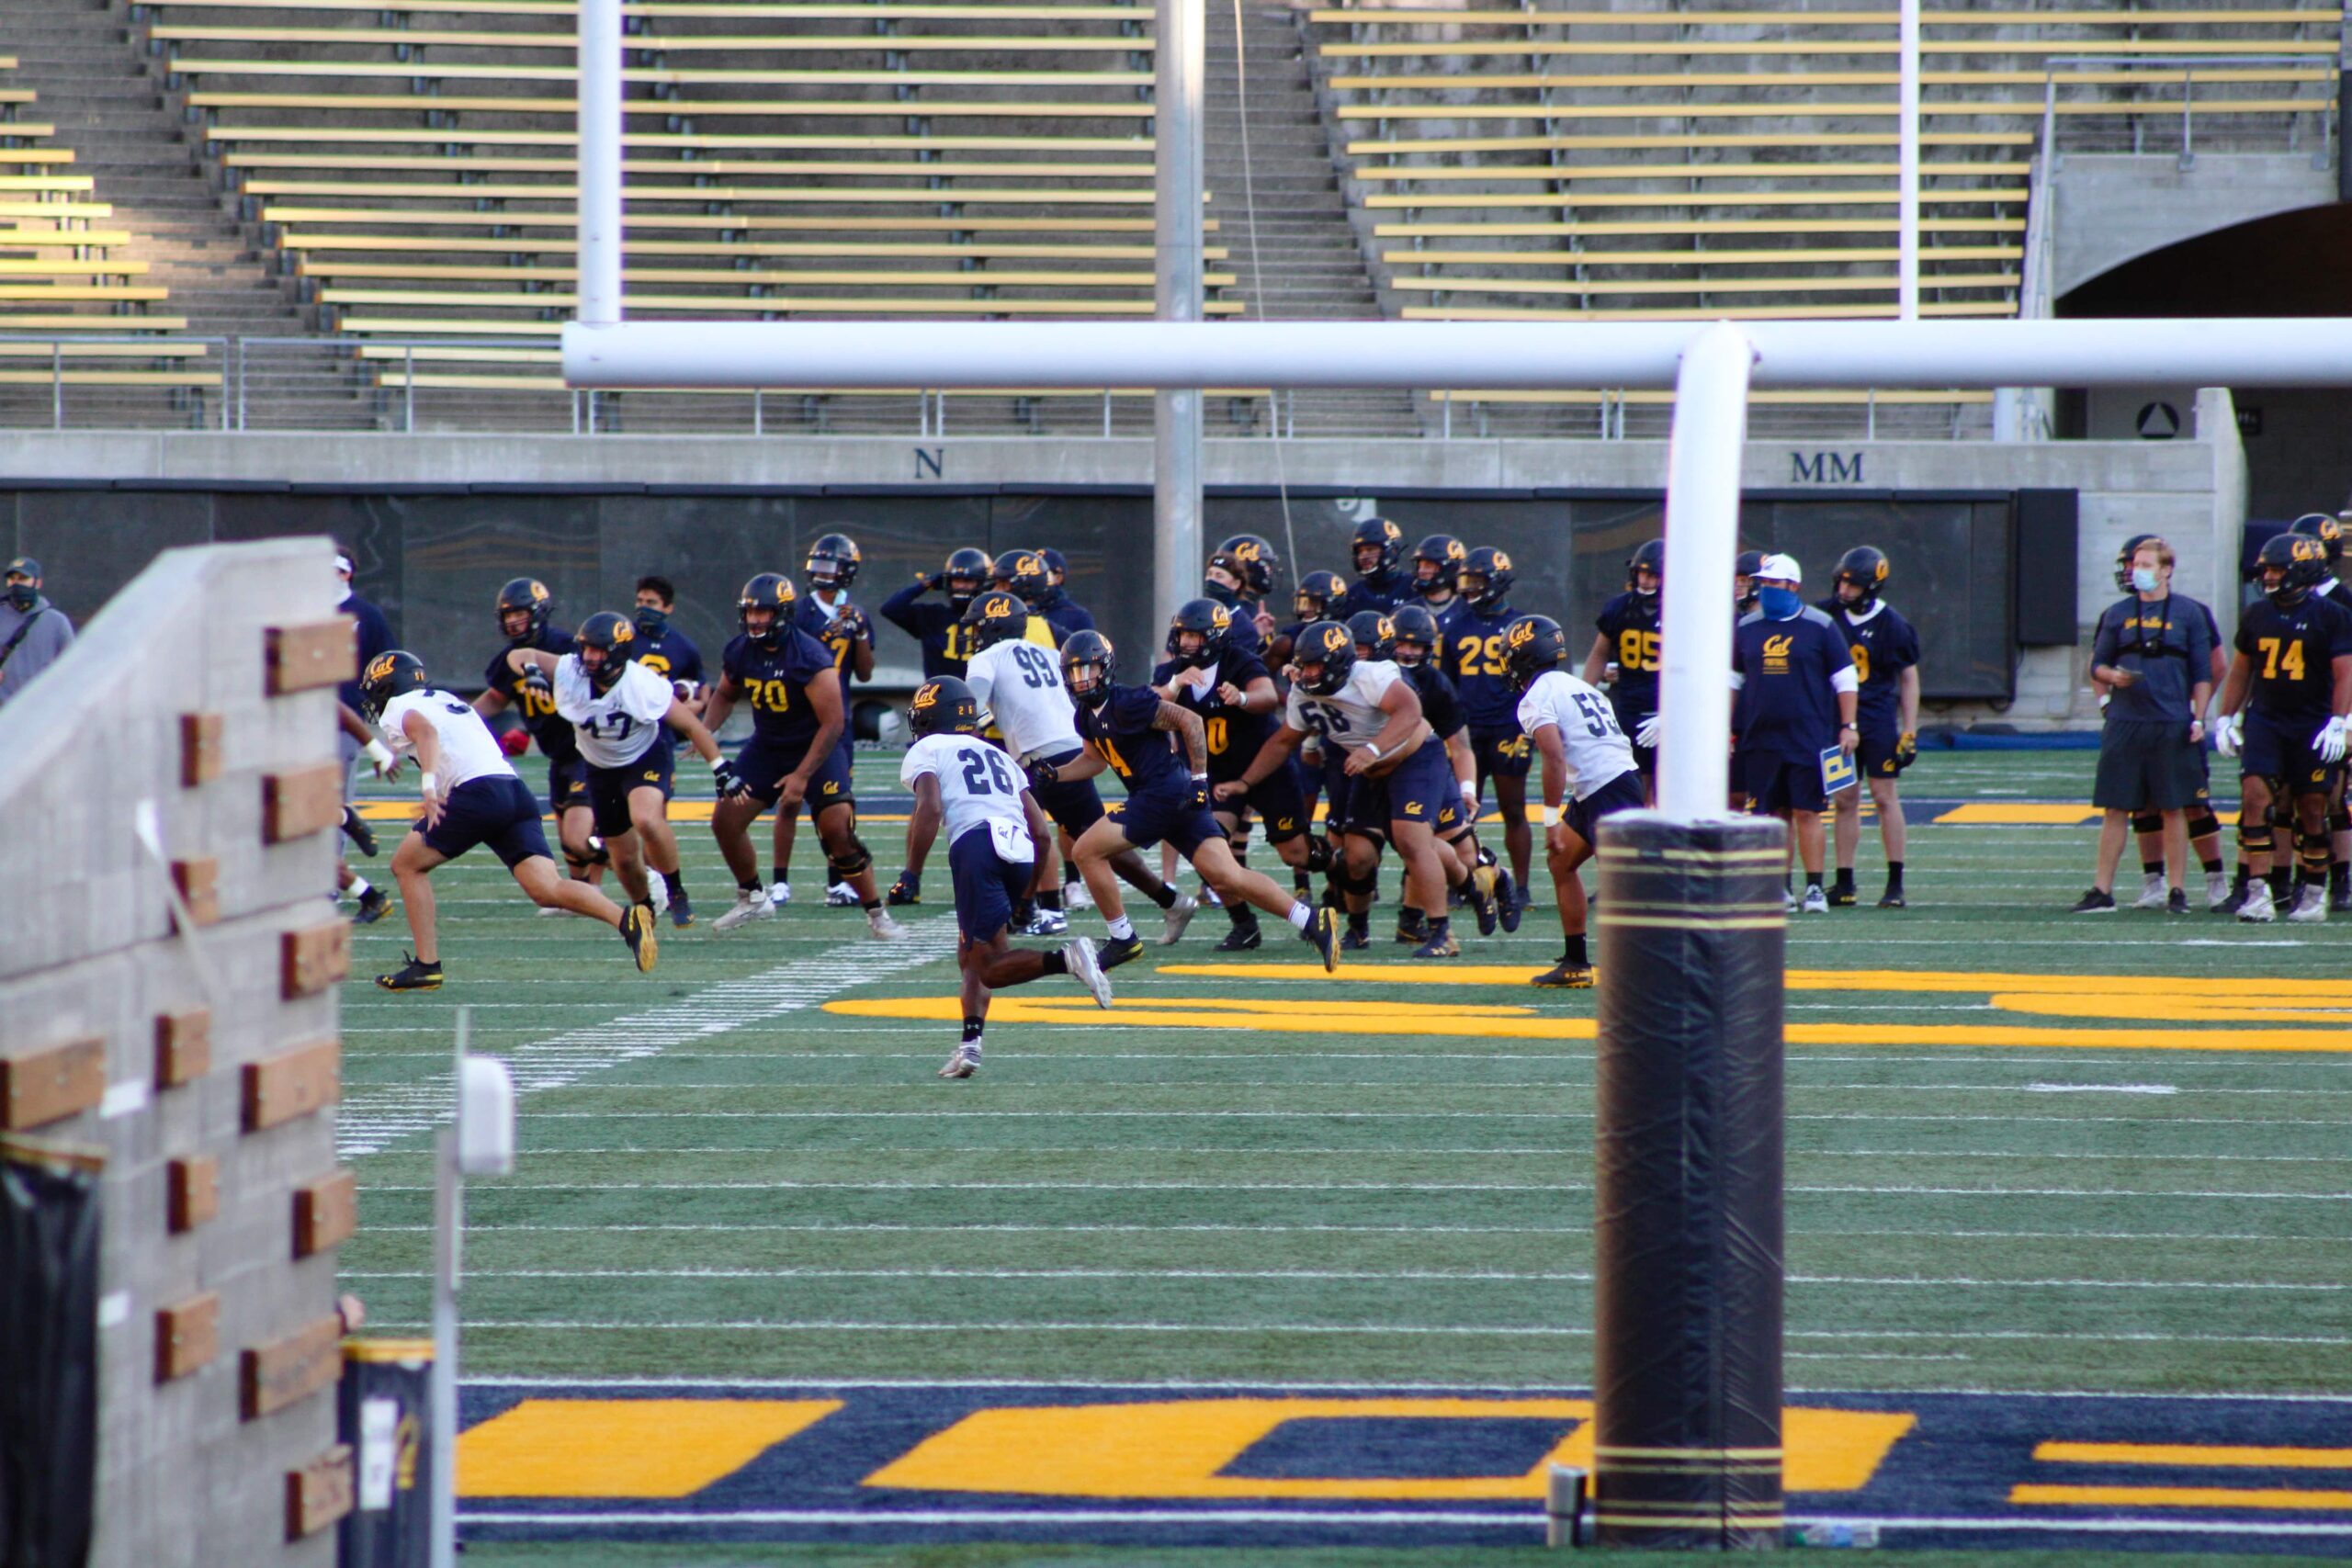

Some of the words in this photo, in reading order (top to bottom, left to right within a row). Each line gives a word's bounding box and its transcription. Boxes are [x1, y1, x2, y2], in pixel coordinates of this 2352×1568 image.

[913, 447, 944, 479] N
[1789, 450, 1865, 483] MM
[1235, 541, 1261, 562] Cal
[1014, 555, 1042, 577] Cal
[984, 596, 1012, 619] Cal
[1323, 626, 1350, 653] Cal
[1508, 620, 1535, 649] Cal
[1762, 634, 1794, 659] Cal
[1619, 628, 1662, 671] 85
[2257, 637, 2306, 682] 74
[369, 654, 396, 682] Cal
[1012, 645, 1059, 690] 99
[743, 677, 790, 714] 70
[913, 682, 941, 710] Cal
[1297, 700, 1351, 736] 58
[956, 747, 1014, 797] 26
[1404, 801, 1424, 816] Cal
[1438, 807, 1455, 824] Cal
